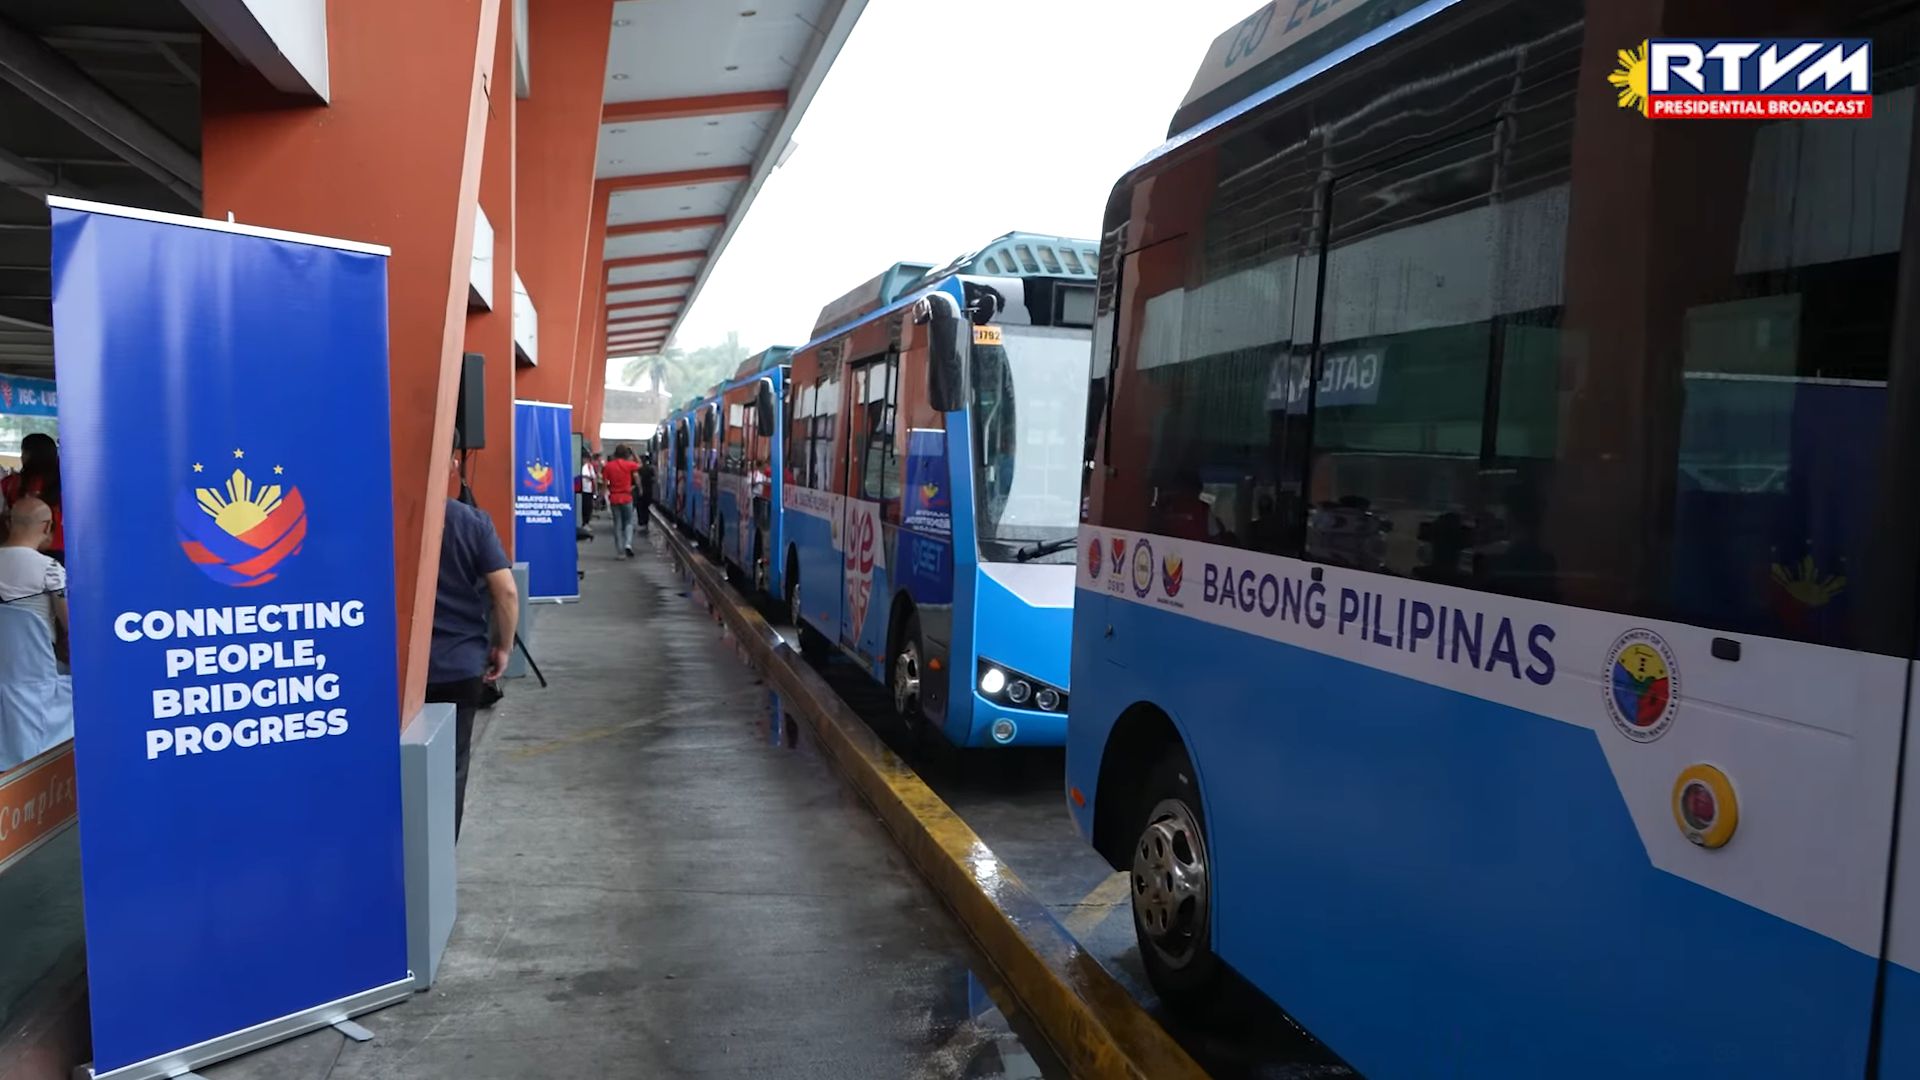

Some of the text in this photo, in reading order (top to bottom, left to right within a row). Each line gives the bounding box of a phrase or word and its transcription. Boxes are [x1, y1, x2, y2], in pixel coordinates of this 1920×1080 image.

[1224, 2, 1277, 68] GO
[515, 502, 572, 511] ANSPORTASYON,
[113, 600, 365, 642] CONNECTING
[1203, 563, 1556, 685] BAGONG PILIPINAS
[166, 639, 326, 679] PEOPLE,
[152, 672, 341, 719] BRIDGING
[146, 708, 349, 760] PROGRESS
[0, 774, 73, 841] Complex
